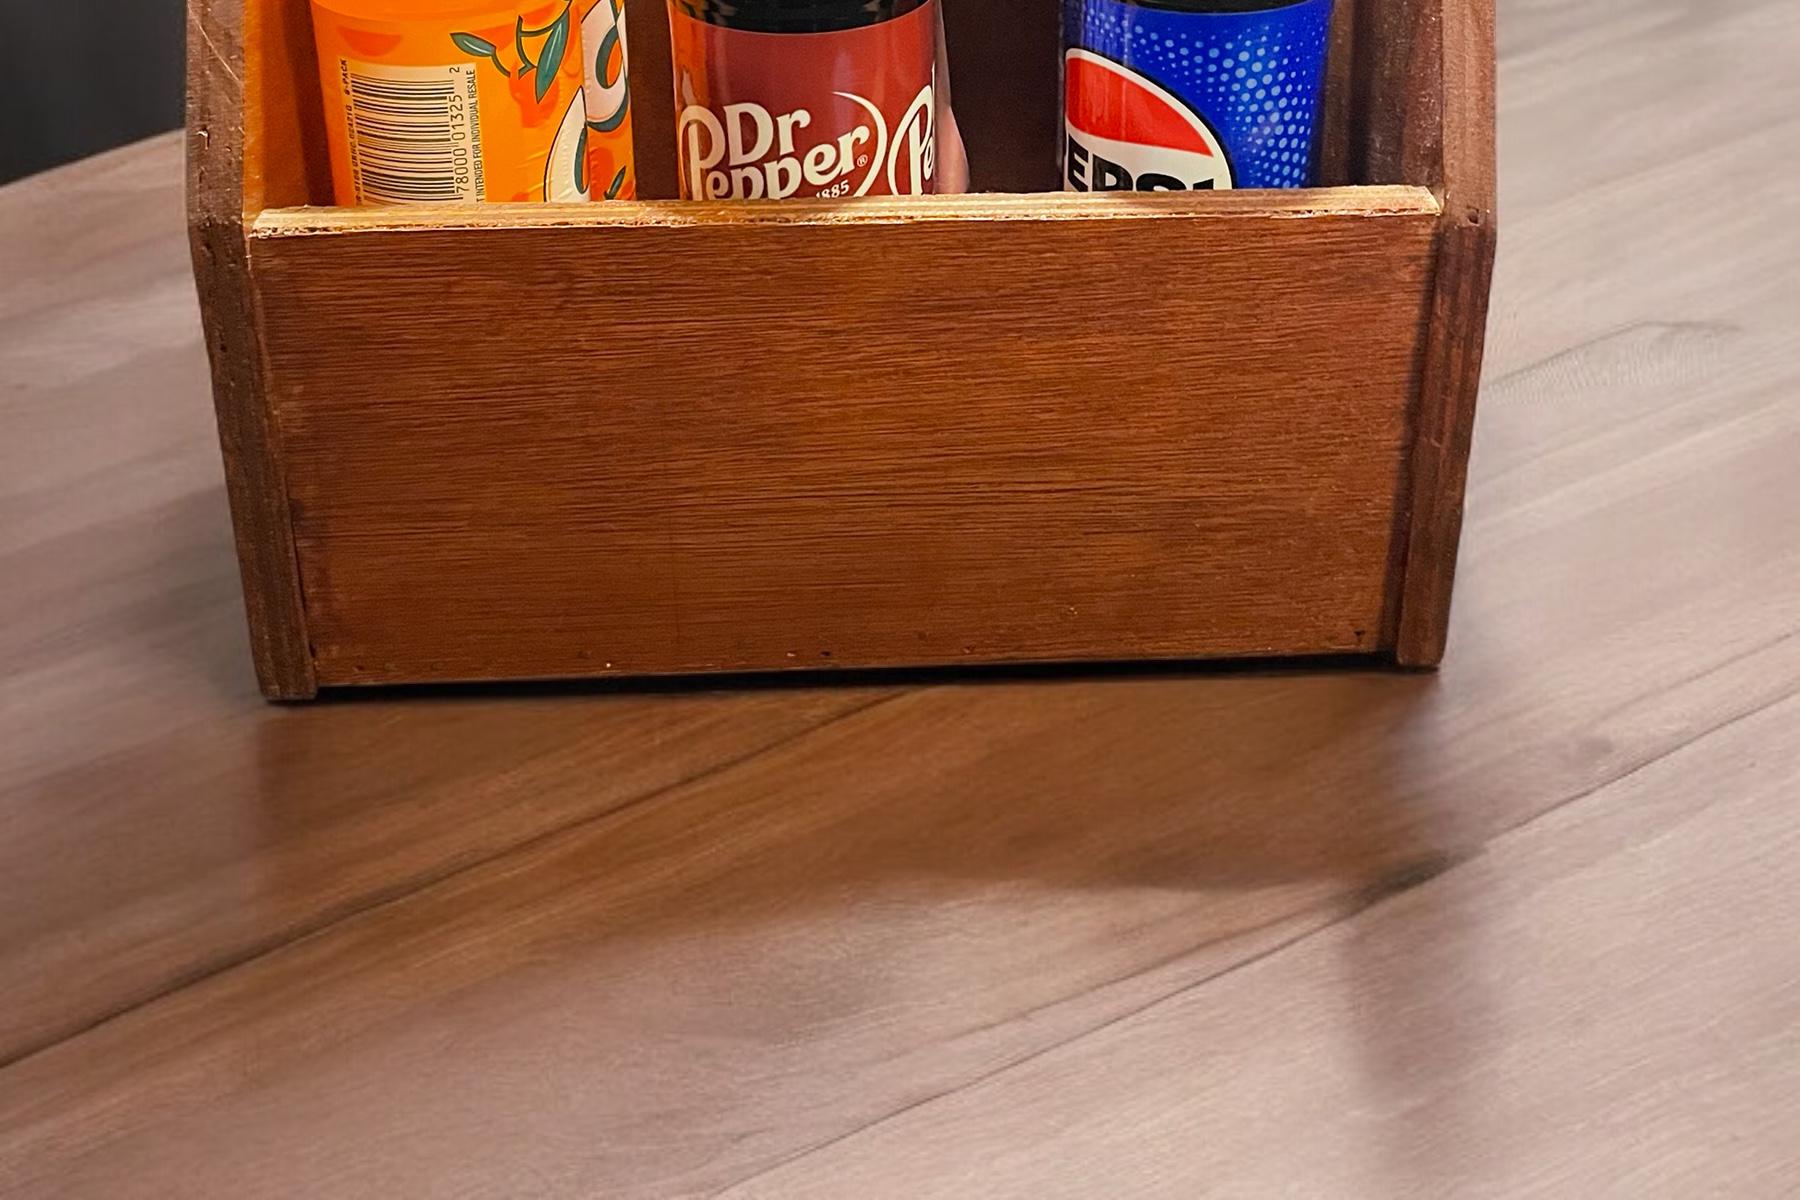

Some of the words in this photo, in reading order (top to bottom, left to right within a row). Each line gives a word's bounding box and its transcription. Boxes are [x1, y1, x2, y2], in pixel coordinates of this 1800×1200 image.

[449, 66, 460, 74] 2
[465, 69, 477, 99] RESALE
[448, 94, 466, 142] 01325
[468, 100, 481, 143] INDIVIDUAL
[723, 102, 811, 166] Dr
[452, 146, 471, 194] 78000
[471, 143, 483, 160] FOR
[679, 104, 871, 201] Pepper
[473, 160, 487, 197] INTENDED
